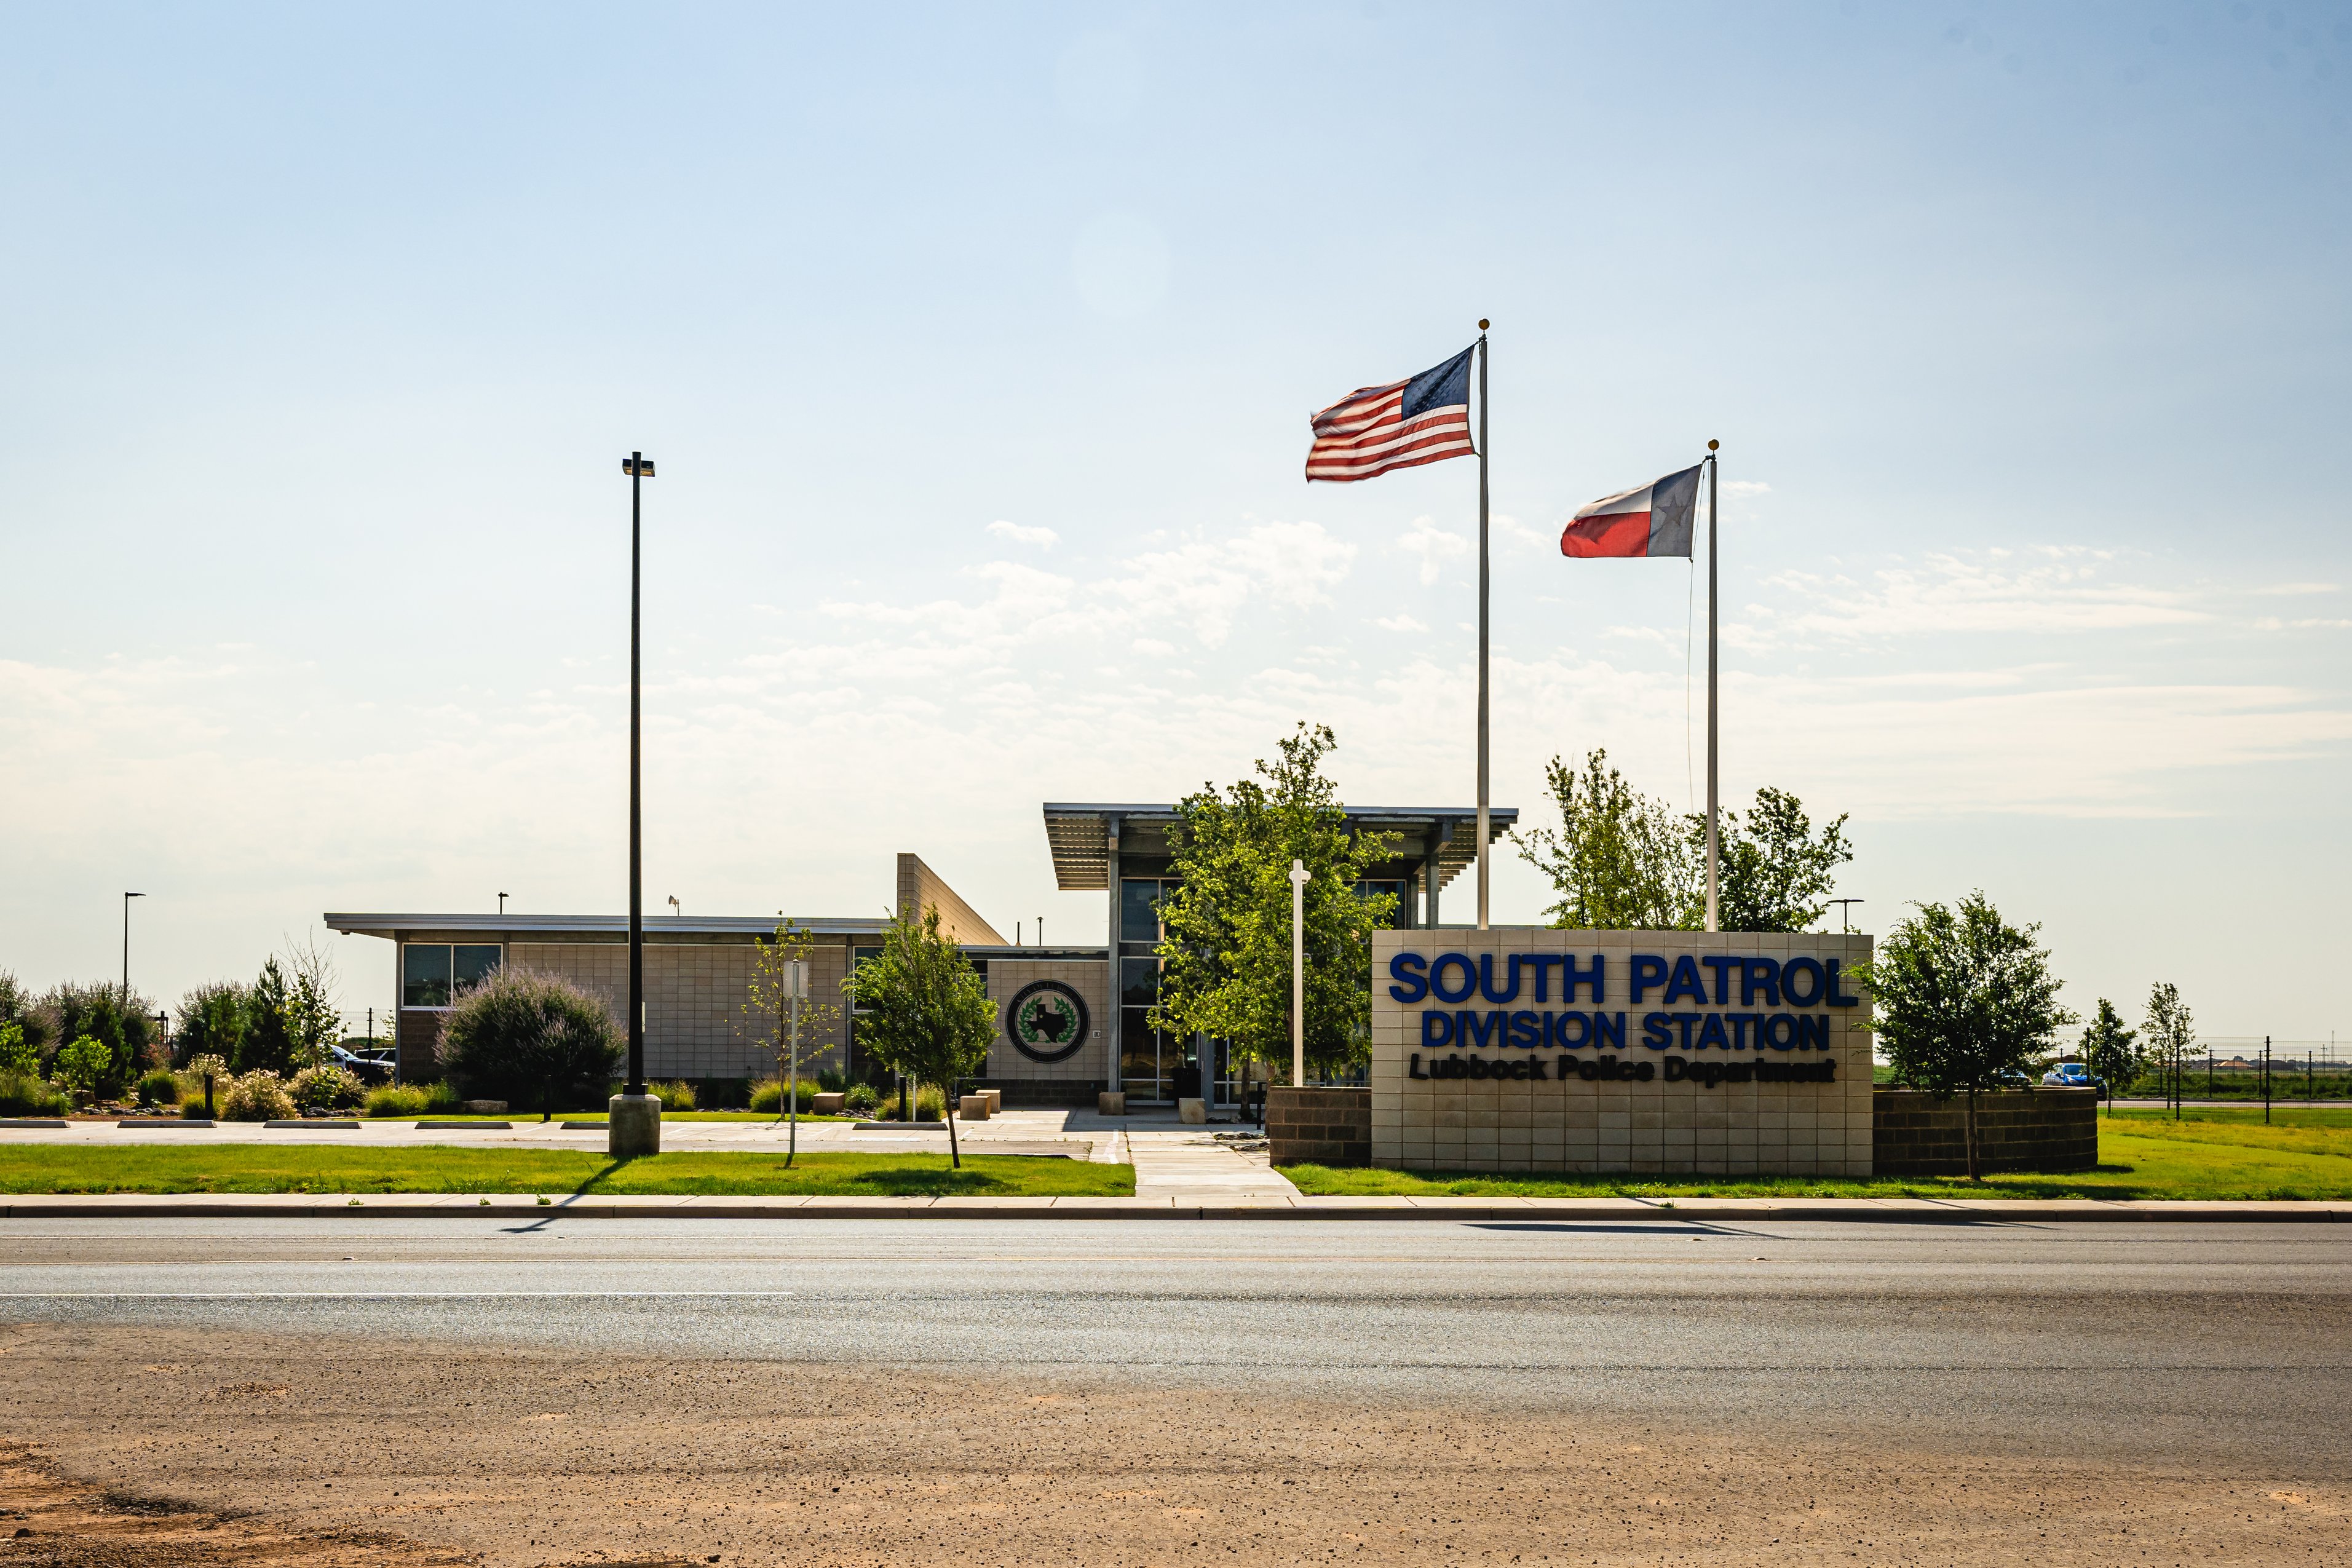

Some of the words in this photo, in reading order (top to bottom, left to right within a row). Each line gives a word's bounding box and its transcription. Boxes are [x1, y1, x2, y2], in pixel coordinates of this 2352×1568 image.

[1388, 953, 1604, 1004] SOUTH
[1630, 955, 1859, 1007] PATROL
[1422, 1010, 1626, 1049] DIVISION
[1642, 1012, 1829, 1051] STATION
[1409, 1053, 1548, 1080] Lubbock
[1558, 1055, 1655, 1081] Police
[1665, 1056, 1836, 1088] Department
